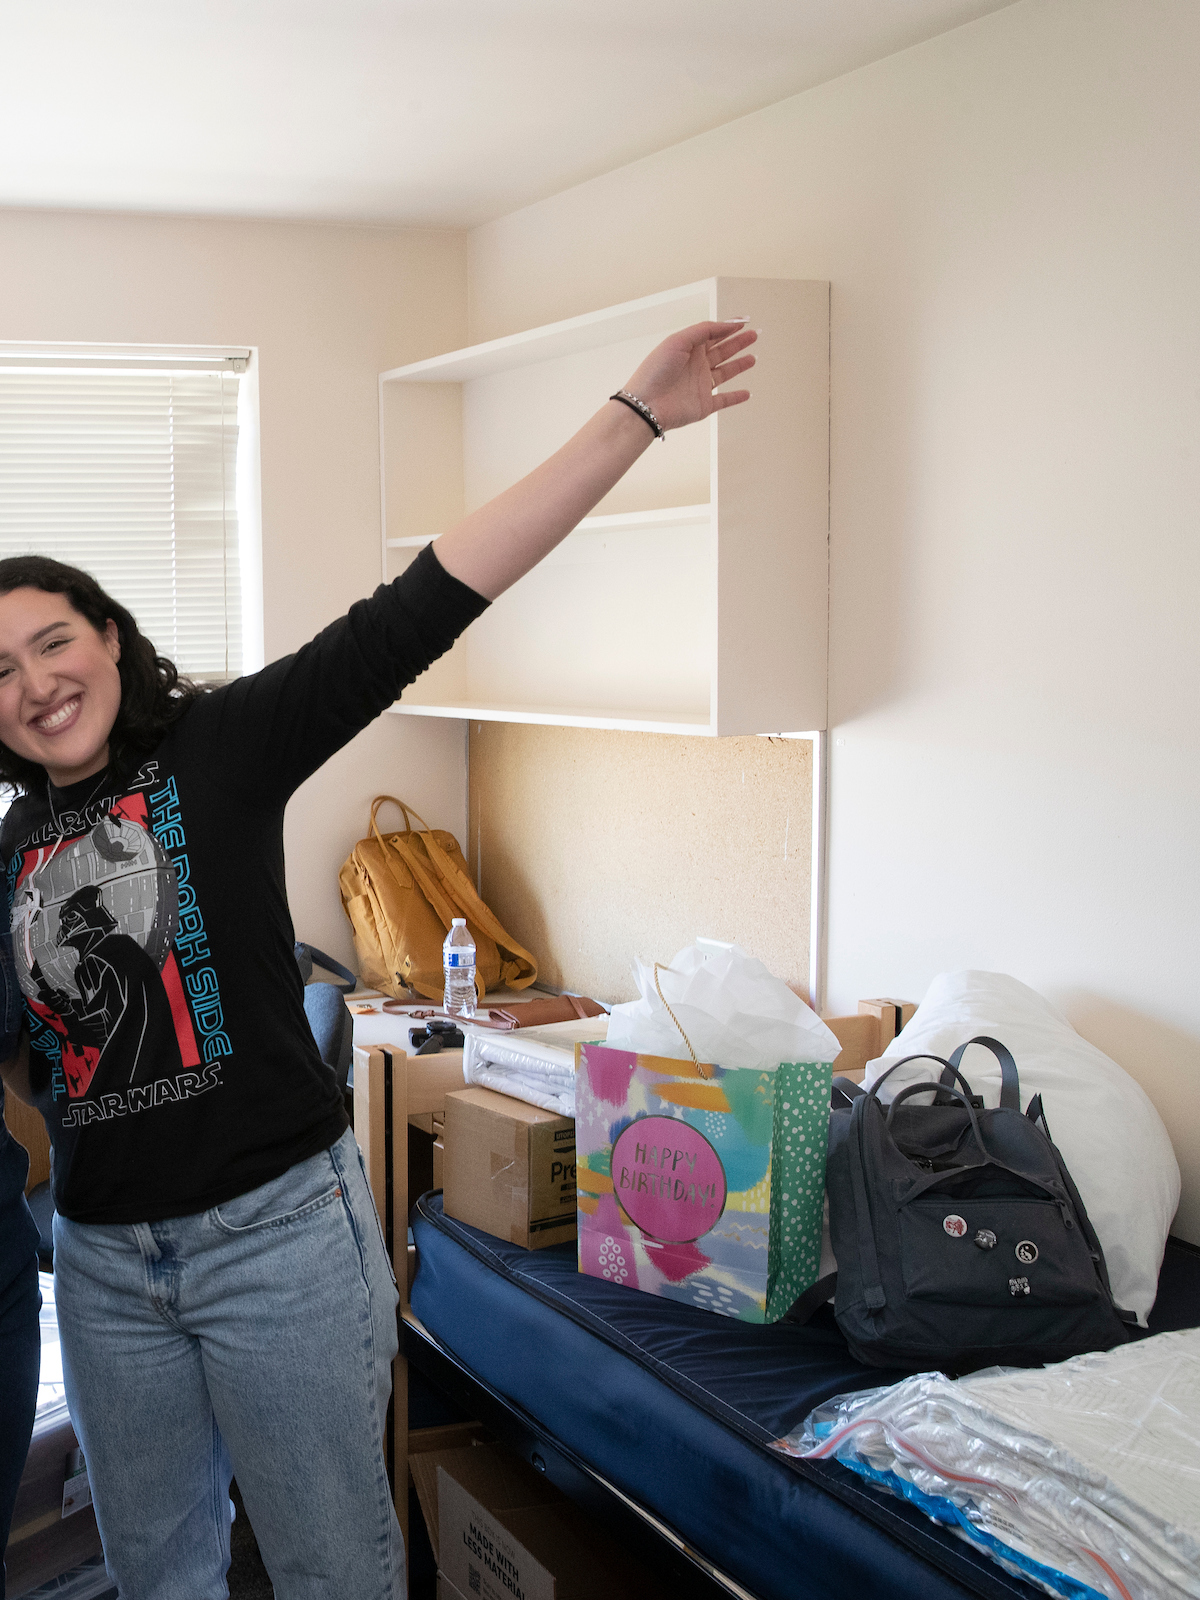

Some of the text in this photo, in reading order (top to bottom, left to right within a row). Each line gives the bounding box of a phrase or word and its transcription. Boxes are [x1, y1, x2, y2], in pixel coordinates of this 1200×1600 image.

[149, 775, 187, 850] THE
[185, 966, 234, 1063] SIDE
[30, 1029, 67, 1102] THE
[61, 1061, 222, 1128] STAR WARS
[619, 1166, 716, 1209] BIRTHDAY!
[634, 1141, 698, 1175] HAPPY
[463, 1531, 482, 1560] LESS
[469, 1521, 494, 1556] MADE
[495, 1548, 519, 1582] WITH
